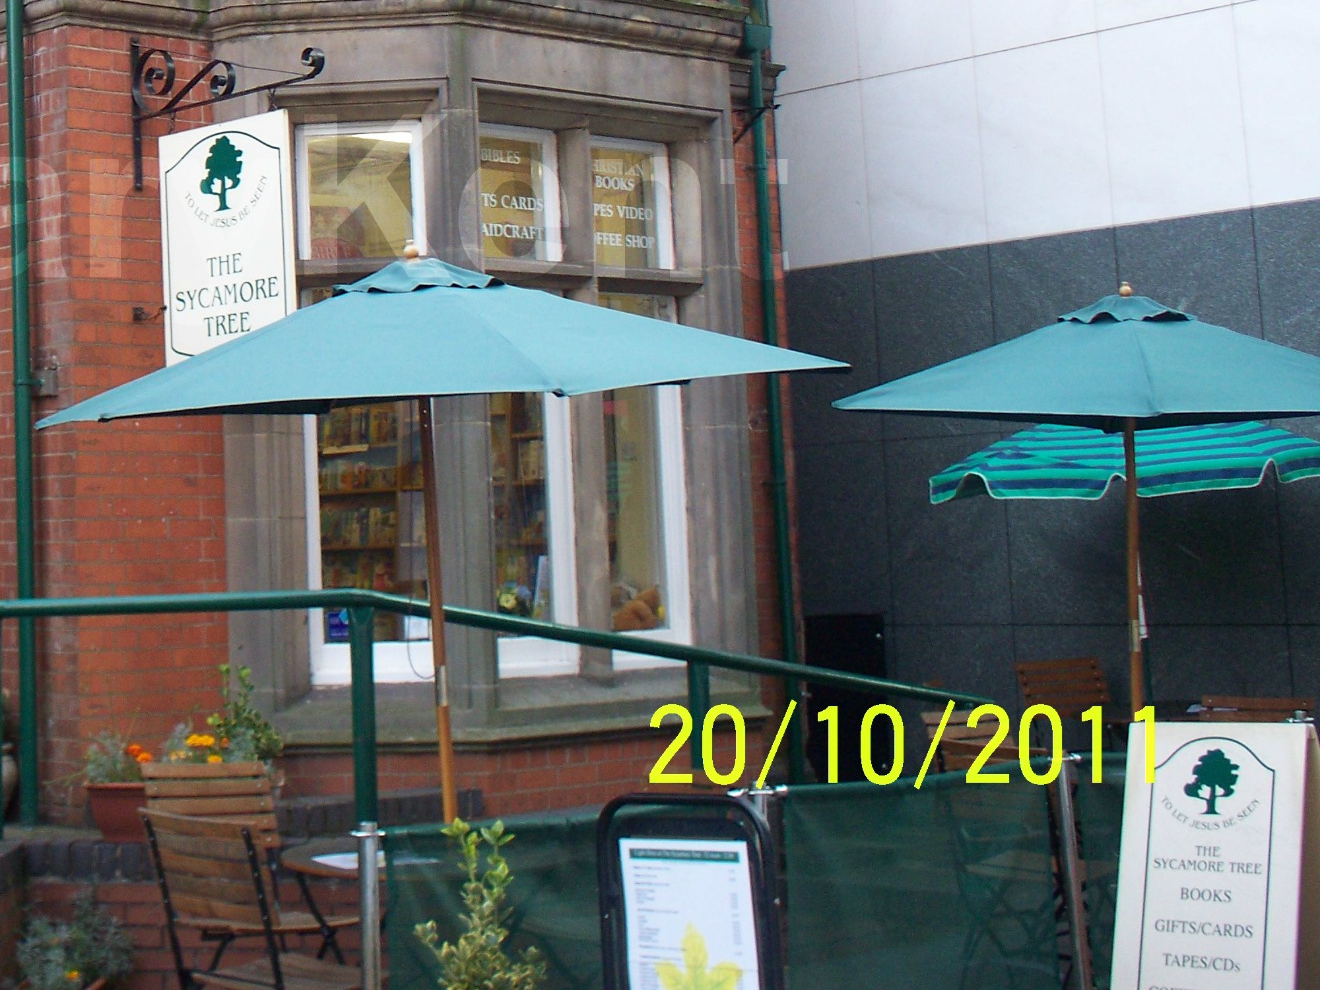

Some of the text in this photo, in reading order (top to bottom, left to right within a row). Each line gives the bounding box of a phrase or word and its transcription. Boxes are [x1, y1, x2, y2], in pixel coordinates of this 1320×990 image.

[481, 148, 521, 165] BIBLES
[595, 175, 635, 192] BOOKS
[184, 174, 268, 228] TO LET JESUS BE SEEN
[501, 195, 544, 212] CARDS
[616, 205, 654, 221] VIDEO
[625, 234, 656, 250] SHOP
[207, 252, 243, 277] THE
[176, 276, 280, 312] SYCAMORE
[204, 311, 251, 337] TREE
[1161, 797, 1261, 831] TO LET JESUS BE SEEN
[1195, 845, 1220, 857] THE
[1153, 858, 1263, 875] SYCAMORE TREE
[1180, 887, 1232, 903] BOOKS
[1154, 918, 1254, 939] GIFTS/CARDS
[1162, 953, 1241, 973] TAPES/CDs
